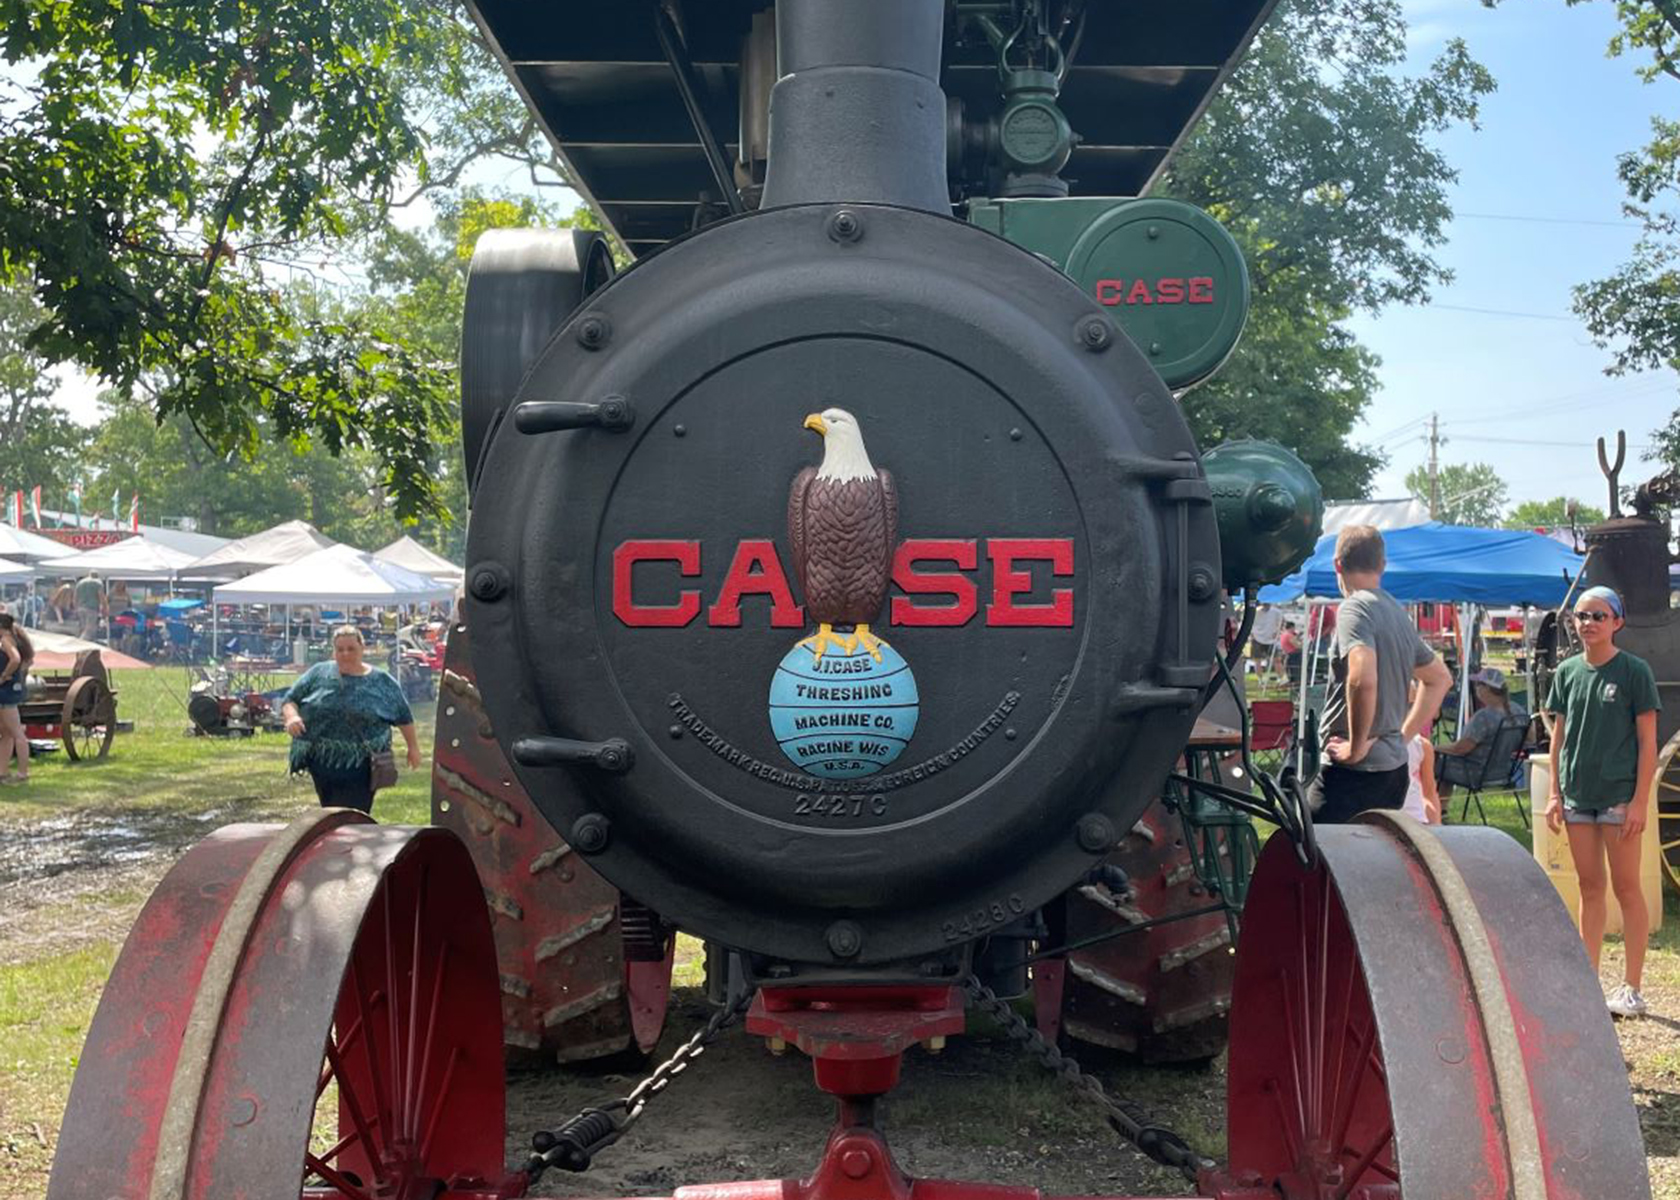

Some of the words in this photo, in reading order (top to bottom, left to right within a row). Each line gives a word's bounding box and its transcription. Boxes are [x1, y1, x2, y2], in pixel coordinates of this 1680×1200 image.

[1096, 277, 1213, 306] CASE
[72, 533, 121, 546] PIZZA
[612, 538, 1075, 628] CASE
[796, 683, 893, 701] THRESHING
[794, 714, 871, 730] MACHINE
[874, 716, 895, 730] CO.
[944, 693, 1019, 762] COUNTRIES
[797, 741, 853, 757] RACINE
[859, 742, 889, 756] WIS
[824, 761, 865, 771] U.S.A.
